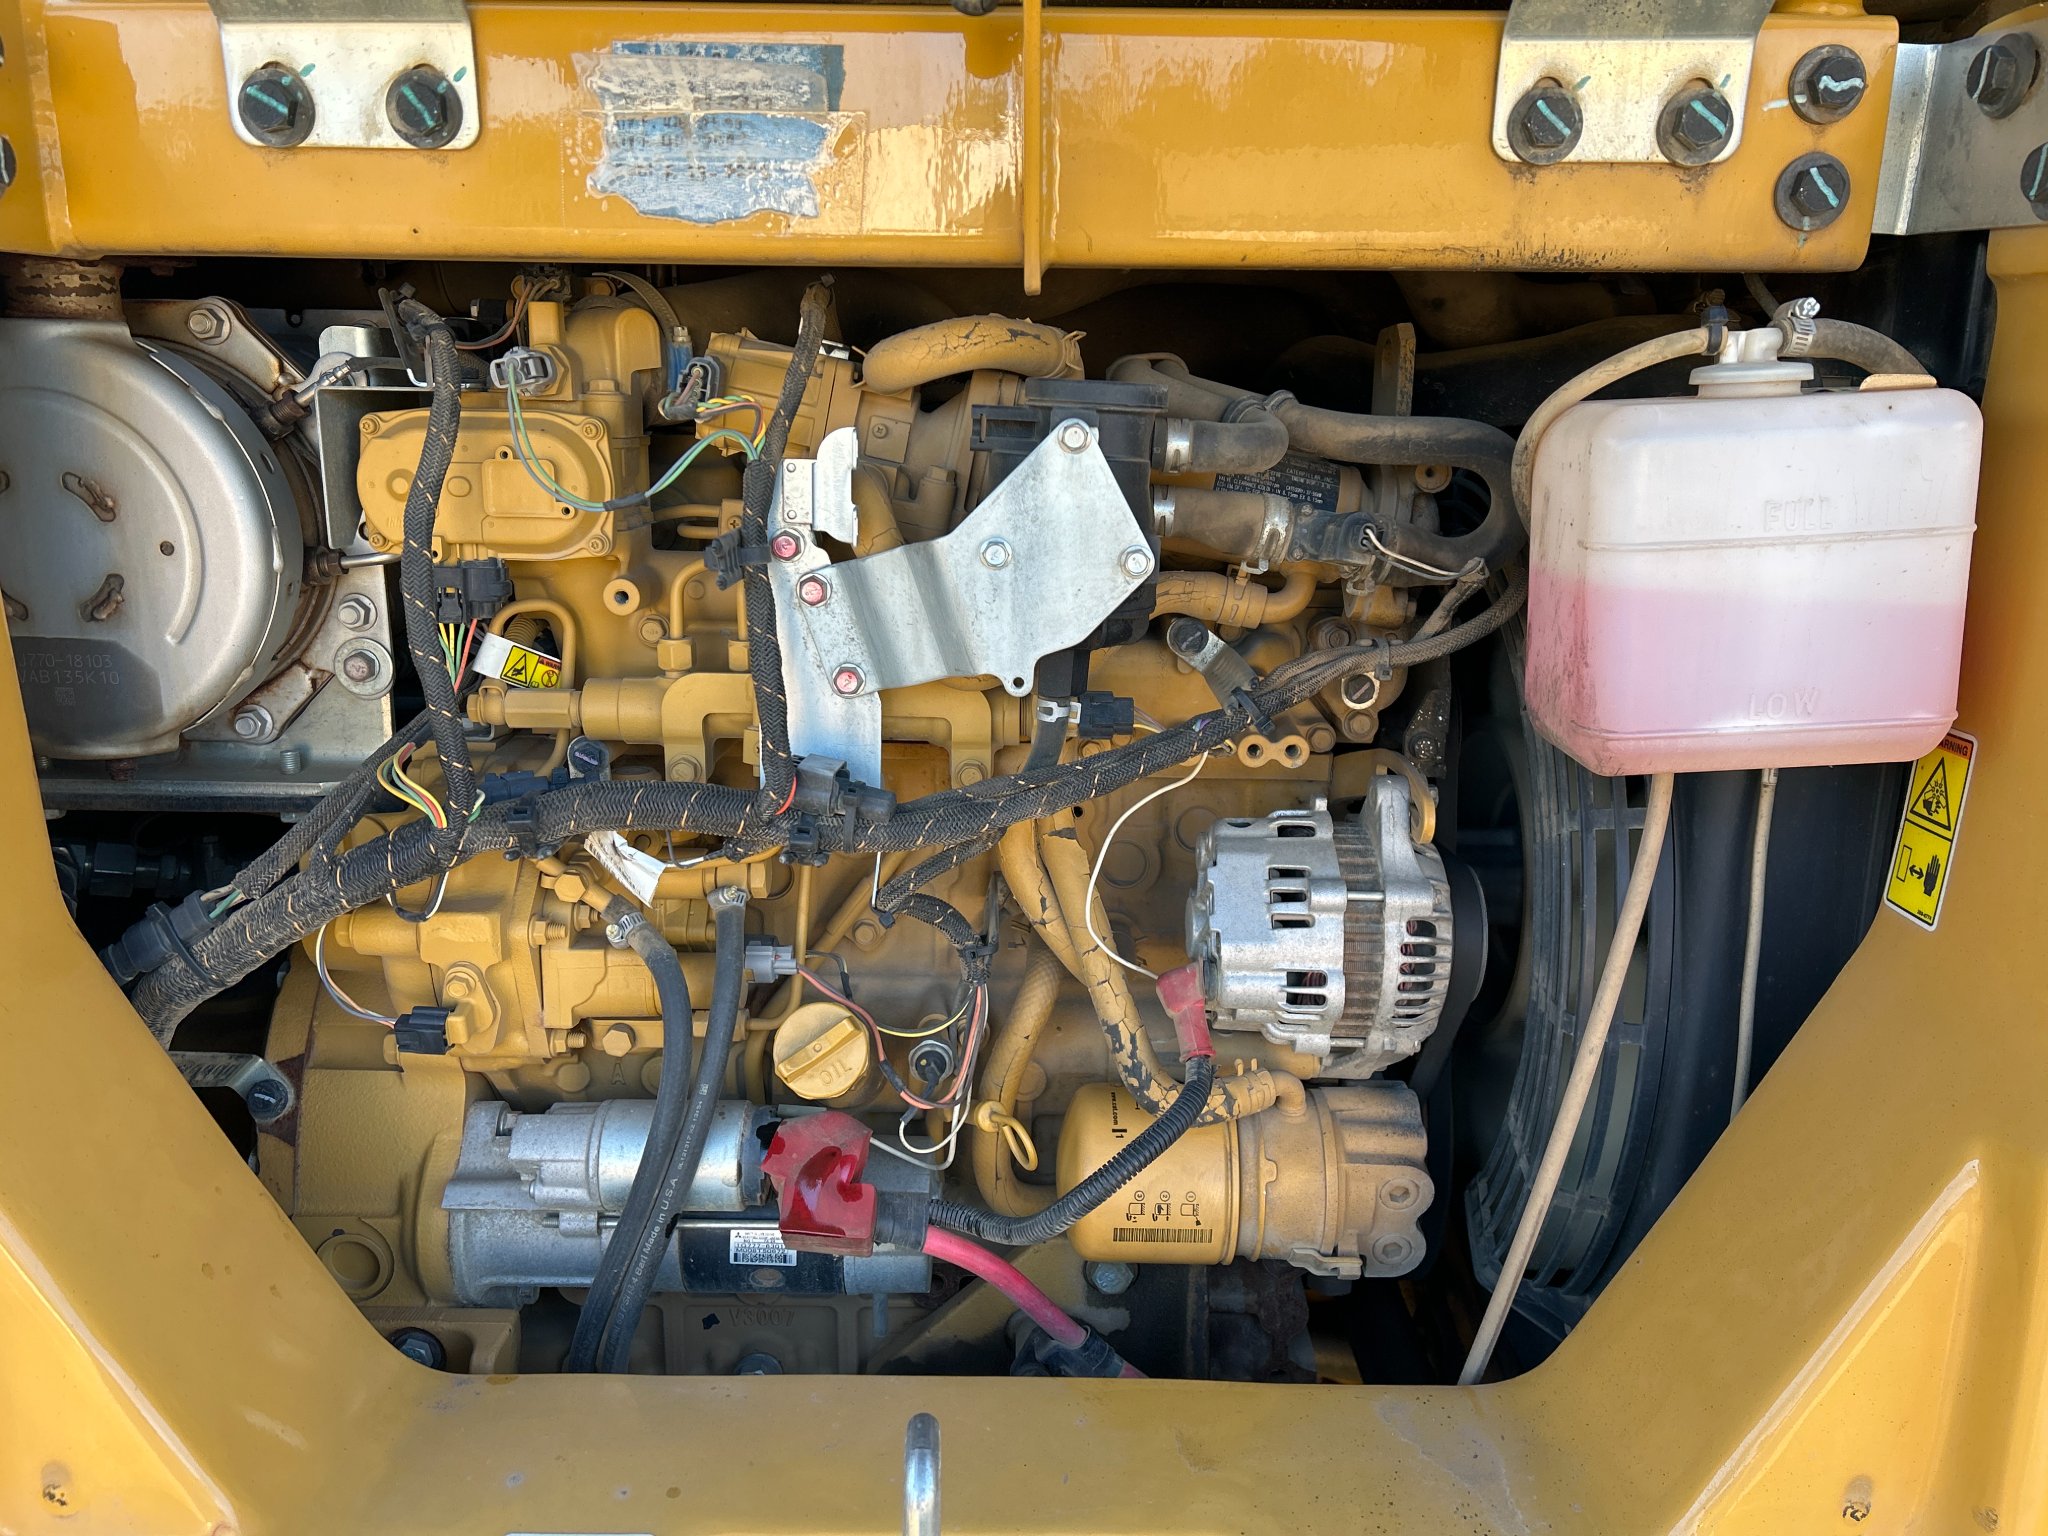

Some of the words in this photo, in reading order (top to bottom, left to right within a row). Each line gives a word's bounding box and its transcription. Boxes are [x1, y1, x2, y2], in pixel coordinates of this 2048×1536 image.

[1763, 496, 1834, 533] FULL
[1748, 686, 1820, 720] LOW
[1939, 739, 1969, 757] ARNING
[820, 1060, 852, 1085] OIL
[642, 1224, 661, 1254] Made
[655, 1212, 667, 1225] in
